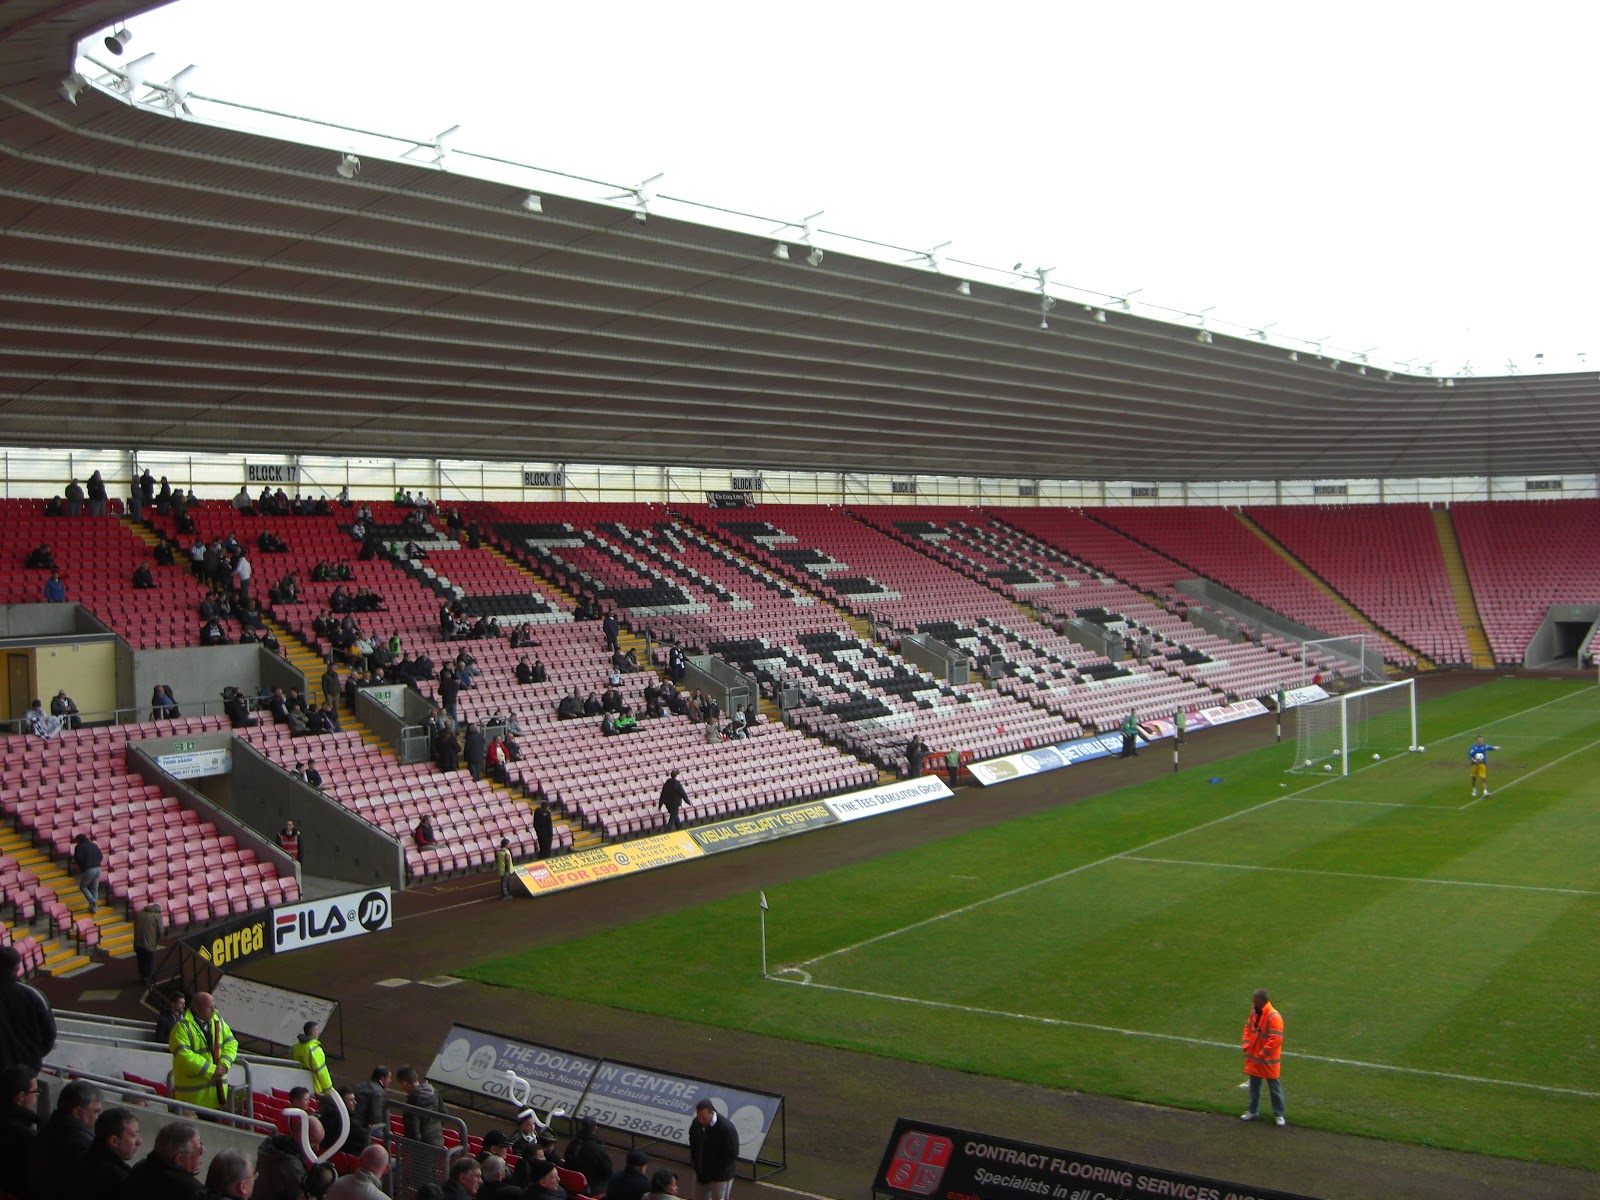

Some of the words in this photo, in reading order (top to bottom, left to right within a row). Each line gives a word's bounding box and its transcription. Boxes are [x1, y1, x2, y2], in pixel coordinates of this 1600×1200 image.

[248, 465, 283, 481] BLOCK
[286, 466, 297, 482] 17
[525, 472, 551, 487] BLOCK
[553, 473, 562, 487] 18
[733, 477, 753, 490] BLOCK
[755, 478, 762, 490] 19
[832, 800, 859, 814] TYNE
[854, 797, 878, 809] TEES
[874, 786, 921, 805] DEMOLITION
[918, 782, 944, 795] GROUP
[696, 828, 740, 845] VISUAL
[734, 814, 784, 835] SECURITY
[781, 805, 830, 824] SYSTEMS
[622, 837, 649, 850] Bristol
[648, 834, 671, 843] Street
[638, 842, 666, 853] Motors
[545, 855, 573, 865] EXPERT
[549, 861, 573, 870] PLUS
[580, 852, 609, 863] YEARS
[613, 851, 631, 866] @
[631, 845, 680, 860] DARLINGTON
[557, 870, 591, 884] FOR
[592, 863, 619, 876] £99
[276, 904, 347, 946] FILA
[502, 1043, 534, 1062] THE
[534, 1050, 619, 1083] DOLPHIN
[620, 1071, 699, 1100] CENTRE
[498, 1058, 515, 1070] The
[516, 1063, 556, 1081] Region's
[556, 1075, 603, 1091] Number
[604, 1082, 610, 1092] 1
[612, 1084, 652, 1101] Leisure
[651, 1093, 693, 1112] Facility
[618, 1114, 685, 1141] 388406
[964, 1141, 1049, 1170] CONTRACT
[1050, 1157, 1133, 1187] FLOORING
[1136, 1175, 1221, 1200] SERVICES
[974, 1167, 1050, 1195] Specialists
[1052, 1183, 1068, 1199] in
